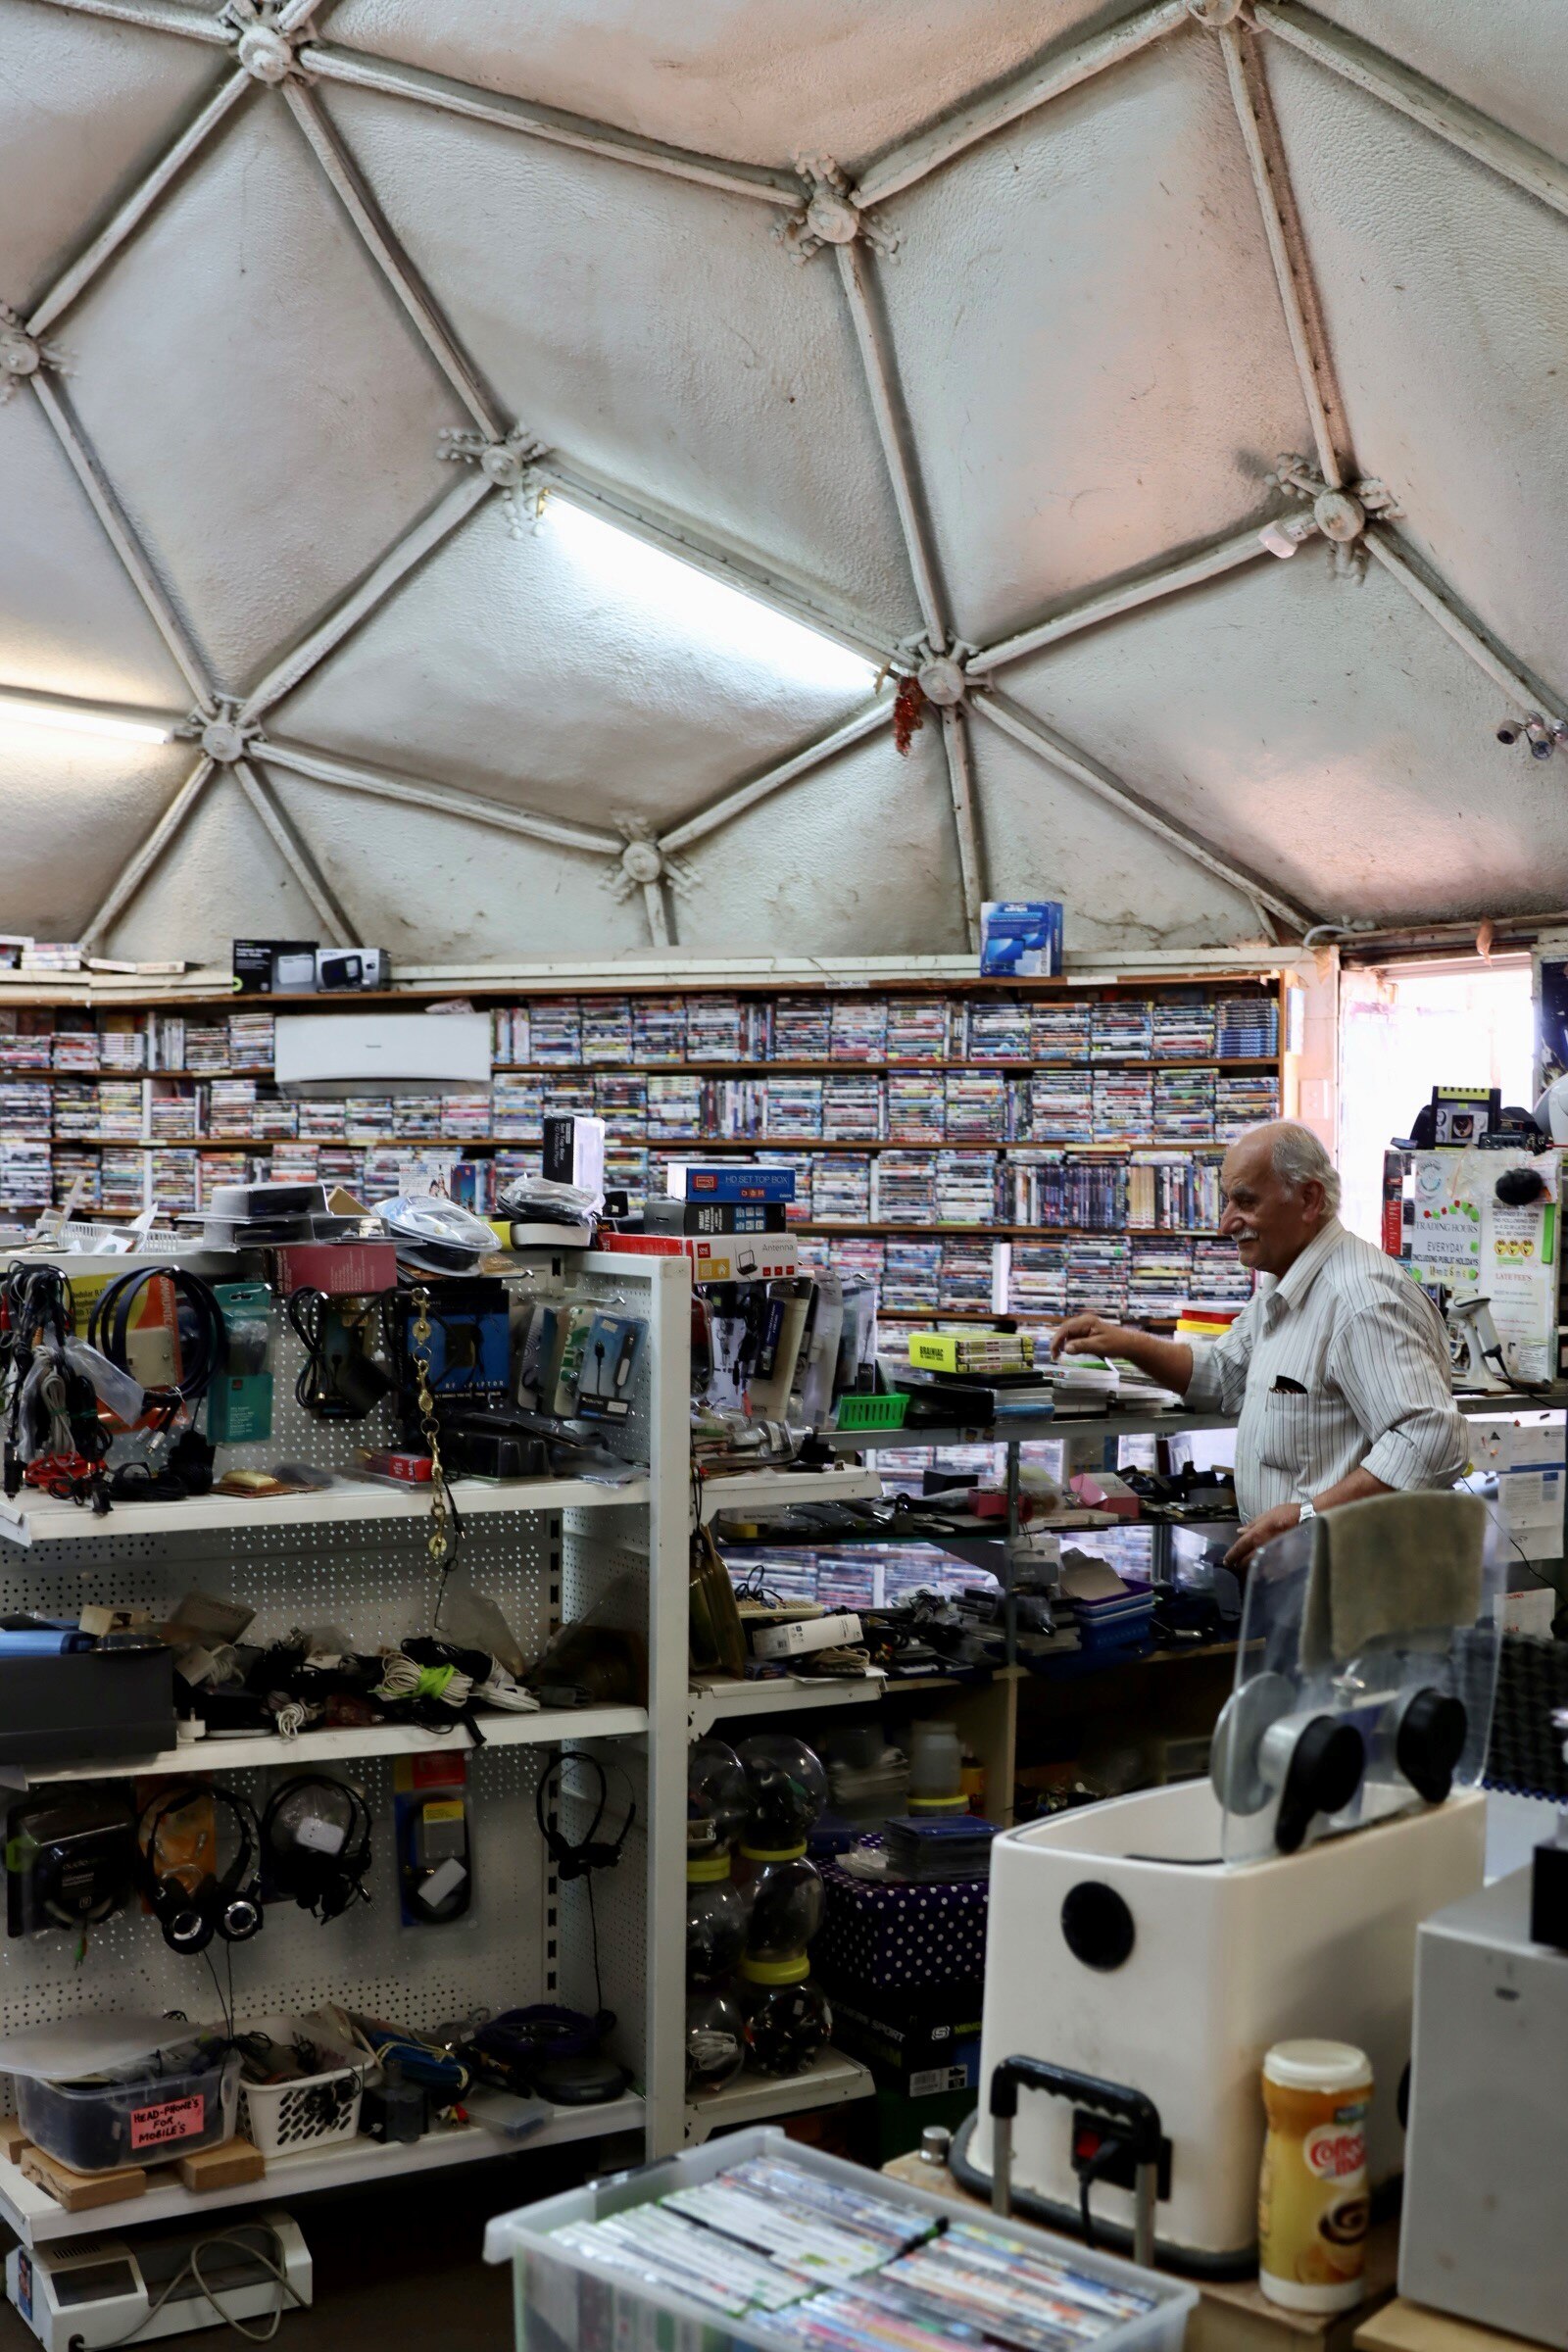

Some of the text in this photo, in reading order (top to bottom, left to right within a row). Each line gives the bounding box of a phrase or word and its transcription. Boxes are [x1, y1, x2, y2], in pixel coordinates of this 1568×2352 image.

[725, 1175, 788, 1184] HD SET TOP BOX
[705, 1222, 710, 1231] TV
[1415, 1221, 1479, 1234] TRADING HOURS
[761, 1243, 794, 1251] Antenna
[1427, 1241, 1464, 1253] EVERYDAY
[1411, 1253, 1479, 1266] INCLUDING PUBLIC HOLIDAYS
[159, 1277, 173, 1326] OMMUNIC
[919, 1346, 944, 1357] BRAINIAC
[871, 2019, 906, 2042] SPORT
[133, 2098, 199, 2123] HEAD-PHONE'S
[153, 2116, 173, 2129] FOR
[138, 2122, 186, 2143] MOBILE'S
